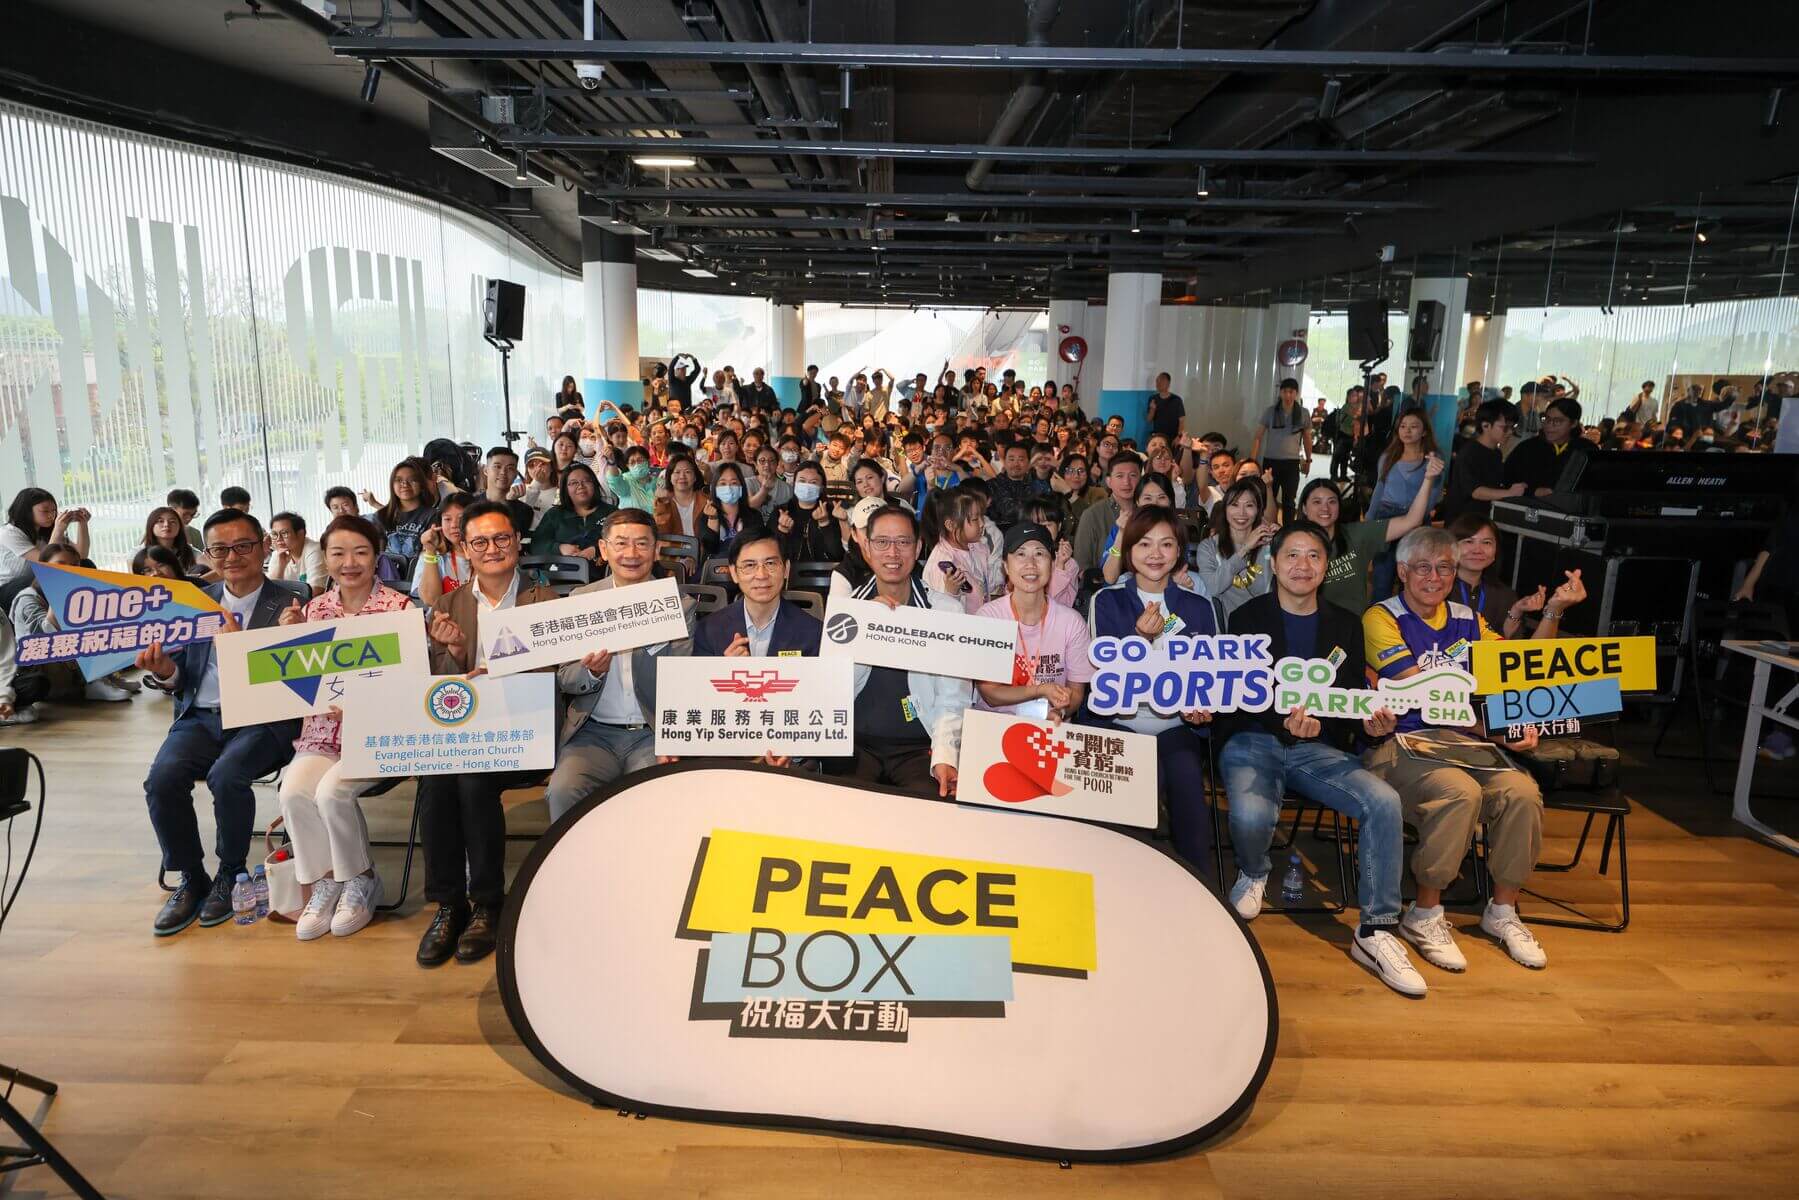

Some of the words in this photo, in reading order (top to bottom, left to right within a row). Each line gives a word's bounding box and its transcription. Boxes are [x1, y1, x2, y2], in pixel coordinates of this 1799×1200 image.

[1666, 476, 1694, 485] ALLEN
[1697, 477, 1727, 486] HEATH
[67, 588, 169, 625] One+
[529, 595, 680, 638] 香港福音盛會有限公司
[532, 636, 558, 649] Hong
[559, 631, 583, 645] Kong
[584, 624, 617, 640] Gospel
[618, 618, 650, 631] Festival
[651, 612, 682, 624] Limited
[865, 632, 896, 643] HONG
[898, 636, 927, 648] KONG
[867, 622, 955, 642] SADDLEBACK
[958, 635, 1014, 650] CHURCH
[270, 639, 383, 677] YWCA
[1093, 640, 1147, 663] GO
[1168, 639, 1267, 661] PARK
[1499, 642, 1623, 683] PEACE
[1281, 662, 1331, 684] GO
[1093, 669, 1268, 709] SPORTS
[1429, 689, 1465, 704] SAI
[1281, 690, 1374, 715] PARK
[1428, 707, 1471, 721] SHA
[1503, 683, 1581, 721] BOX
[662, 708, 848, 726] 康業服務有限公司
[364, 728, 535, 749] 基督教香港信義會社會服務部
[661, 728, 692, 742] Hong
[695, 728, 715, 741] Yip
[718, 728, 763, 740] Service
[766, 728, 821, 742] Company
[825, 728, 848, 740] Ltd.
[375, 747, 434, 761] Evangelical
[437, 746, 485, 758] Lutheran
[487, 744, 524, 755] Church
[379, 760, 411, 773] Social
[414, 759, 453, 772] Service
[462, 759, 491, 771] Hong
[493, 757, 520, 769] Kong
[1083, 777, 1113, 795] POOR
[752, 856, 1019, 928] PEACE
[741, 926, 916, 995] BOX
[740, 996, 909, 1034] 祝福大行動
